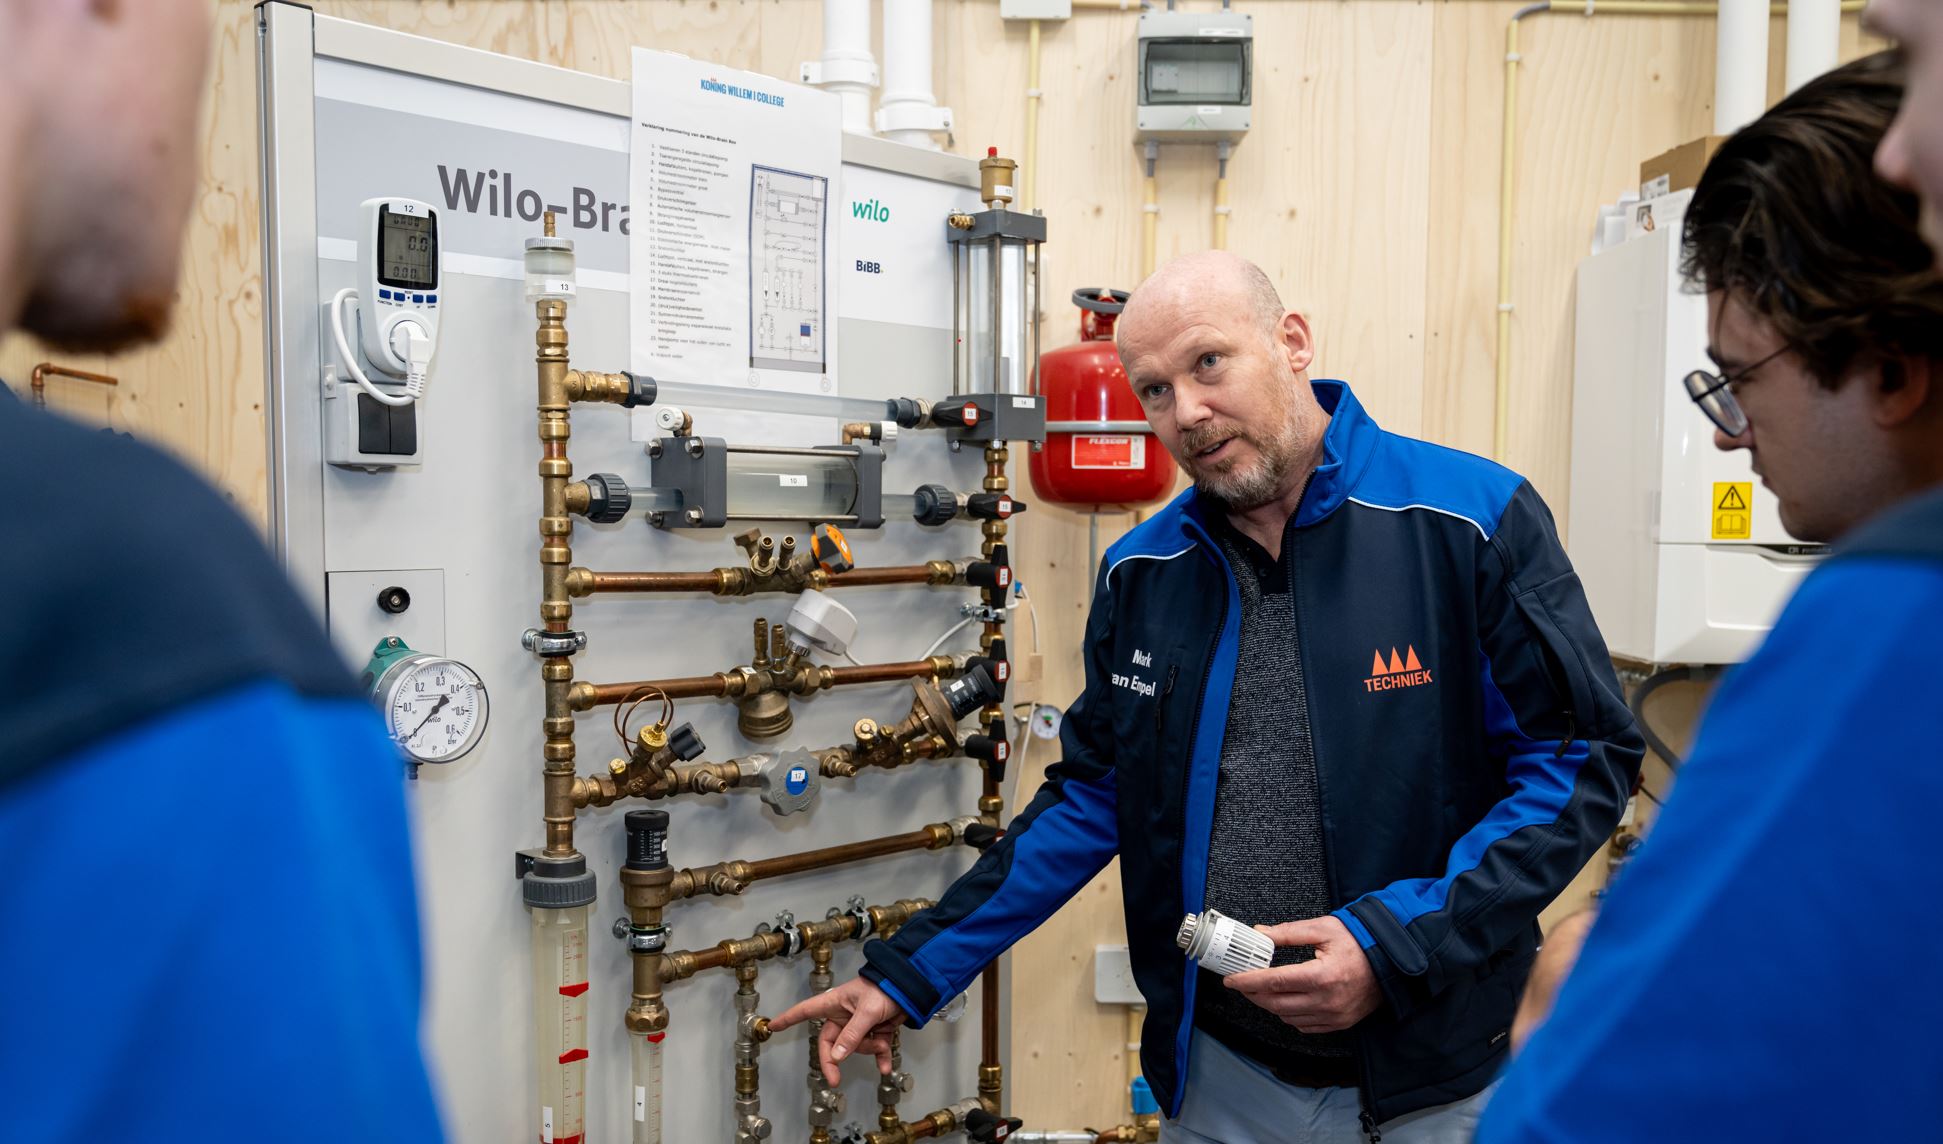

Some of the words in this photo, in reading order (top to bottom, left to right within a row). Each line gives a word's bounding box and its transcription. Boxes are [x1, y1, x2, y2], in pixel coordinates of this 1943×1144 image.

[700, 79, 727, 95] KONING
[728, 85, 753, 100] WILLEM
[757, 92, 785, 108] COLLEGE
[404, 204, 414, 213] 12
[852, 199, 890, 223] wilo
[408, 235, 428, 253] 0.0
[560, 283, 569, 291] 13
[1132, 649, 1152, 668] Mark
[435, 676, 446, 687] 0,3
[1111, 672, 1130, 688] an
[1363, 669, 1433, 692] TECHNIEK
[415, 682, 425, 692] 0,2
[450, 684, 460, 694] 0,4
[403, 702, 412, 712] 0,1
[455, 706, 465, 716] 0,5
[544, 1121, 551, 1129] 5
